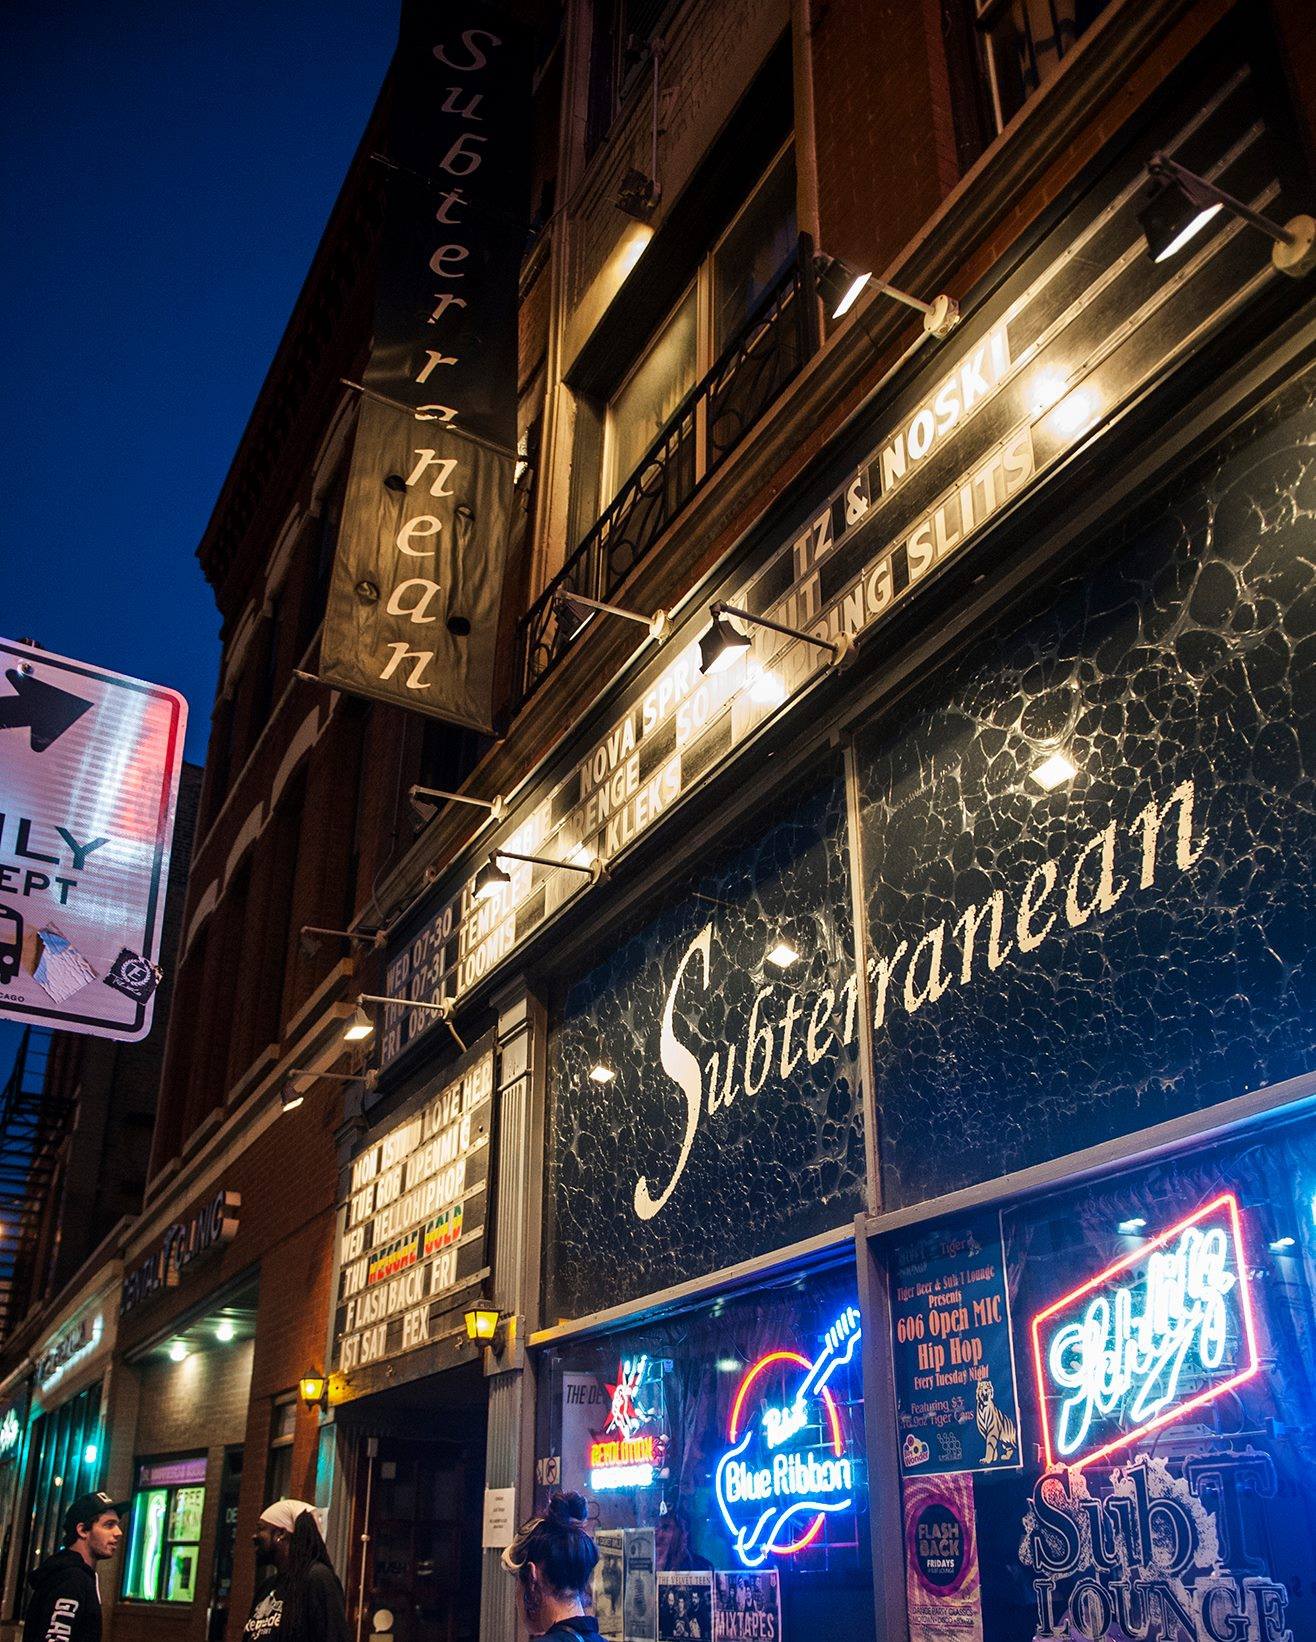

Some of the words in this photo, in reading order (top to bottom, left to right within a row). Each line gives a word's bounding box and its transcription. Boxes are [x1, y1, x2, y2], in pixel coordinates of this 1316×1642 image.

[386, 953, 410, 992] WED
[413, 907, 453, 968] 07-30
[580, 719, 636, 800] NOVA
[847, 477, 869, 525] &
[883, 325, 1010, 491] NOSKI
[381, 1023, 402, 1066] FRI
[606, 757, 680, 851] KLEKS
[908, 428, 1035, 580] SLITS
[0, 813, 110, 871] LY
[411, 946, 446, 1001] 07-31
[634, 779, 1209, 1219] Subterranean
[423, 1086, 459, 1140] LOVE
[351, 1186, 373, 1225] TUE
[377, 1167, 402, 1210] 606
[341, 1225, 364, 1264] WED
[345, 1258, 367, 1290] THU
[431, 1250, 457, 1294] FRI
[928, 1289, 962, 1308] Presents
[898, 1314, 923, 1343] 606
[928, 1304, 969, 1341] Open
[973, 1295, 1002, 1331] MIC
[361, 1325, 386, 1362] SAT
[918, 1342, 945, 1372] Hip
[950, 1336, 983, 1367] Hop
[567, 1385, 586, 1404] THE
[914, 1375, 933, 1391] Every
[936, 1370, 967, 1386] Tuesday
[969, 1364, 989, 1381] Night
[911, 1400, 950, 1415] Featuring
[931, 1412, 951, 1427] Tiger
[726, 1460, 771, 1503] Blue
[774, 1453, 851, 1496] Ribbon
[918, 1523, 959, 1539] FLASH
[919, 1540, 960, 1556] BACK
[926, 1559, 955, 1568] FRIDAYS
[715, 1611, 775, 1639] MIXTAPES
[1032, 1577, 1293, 1642] LOUNGE
